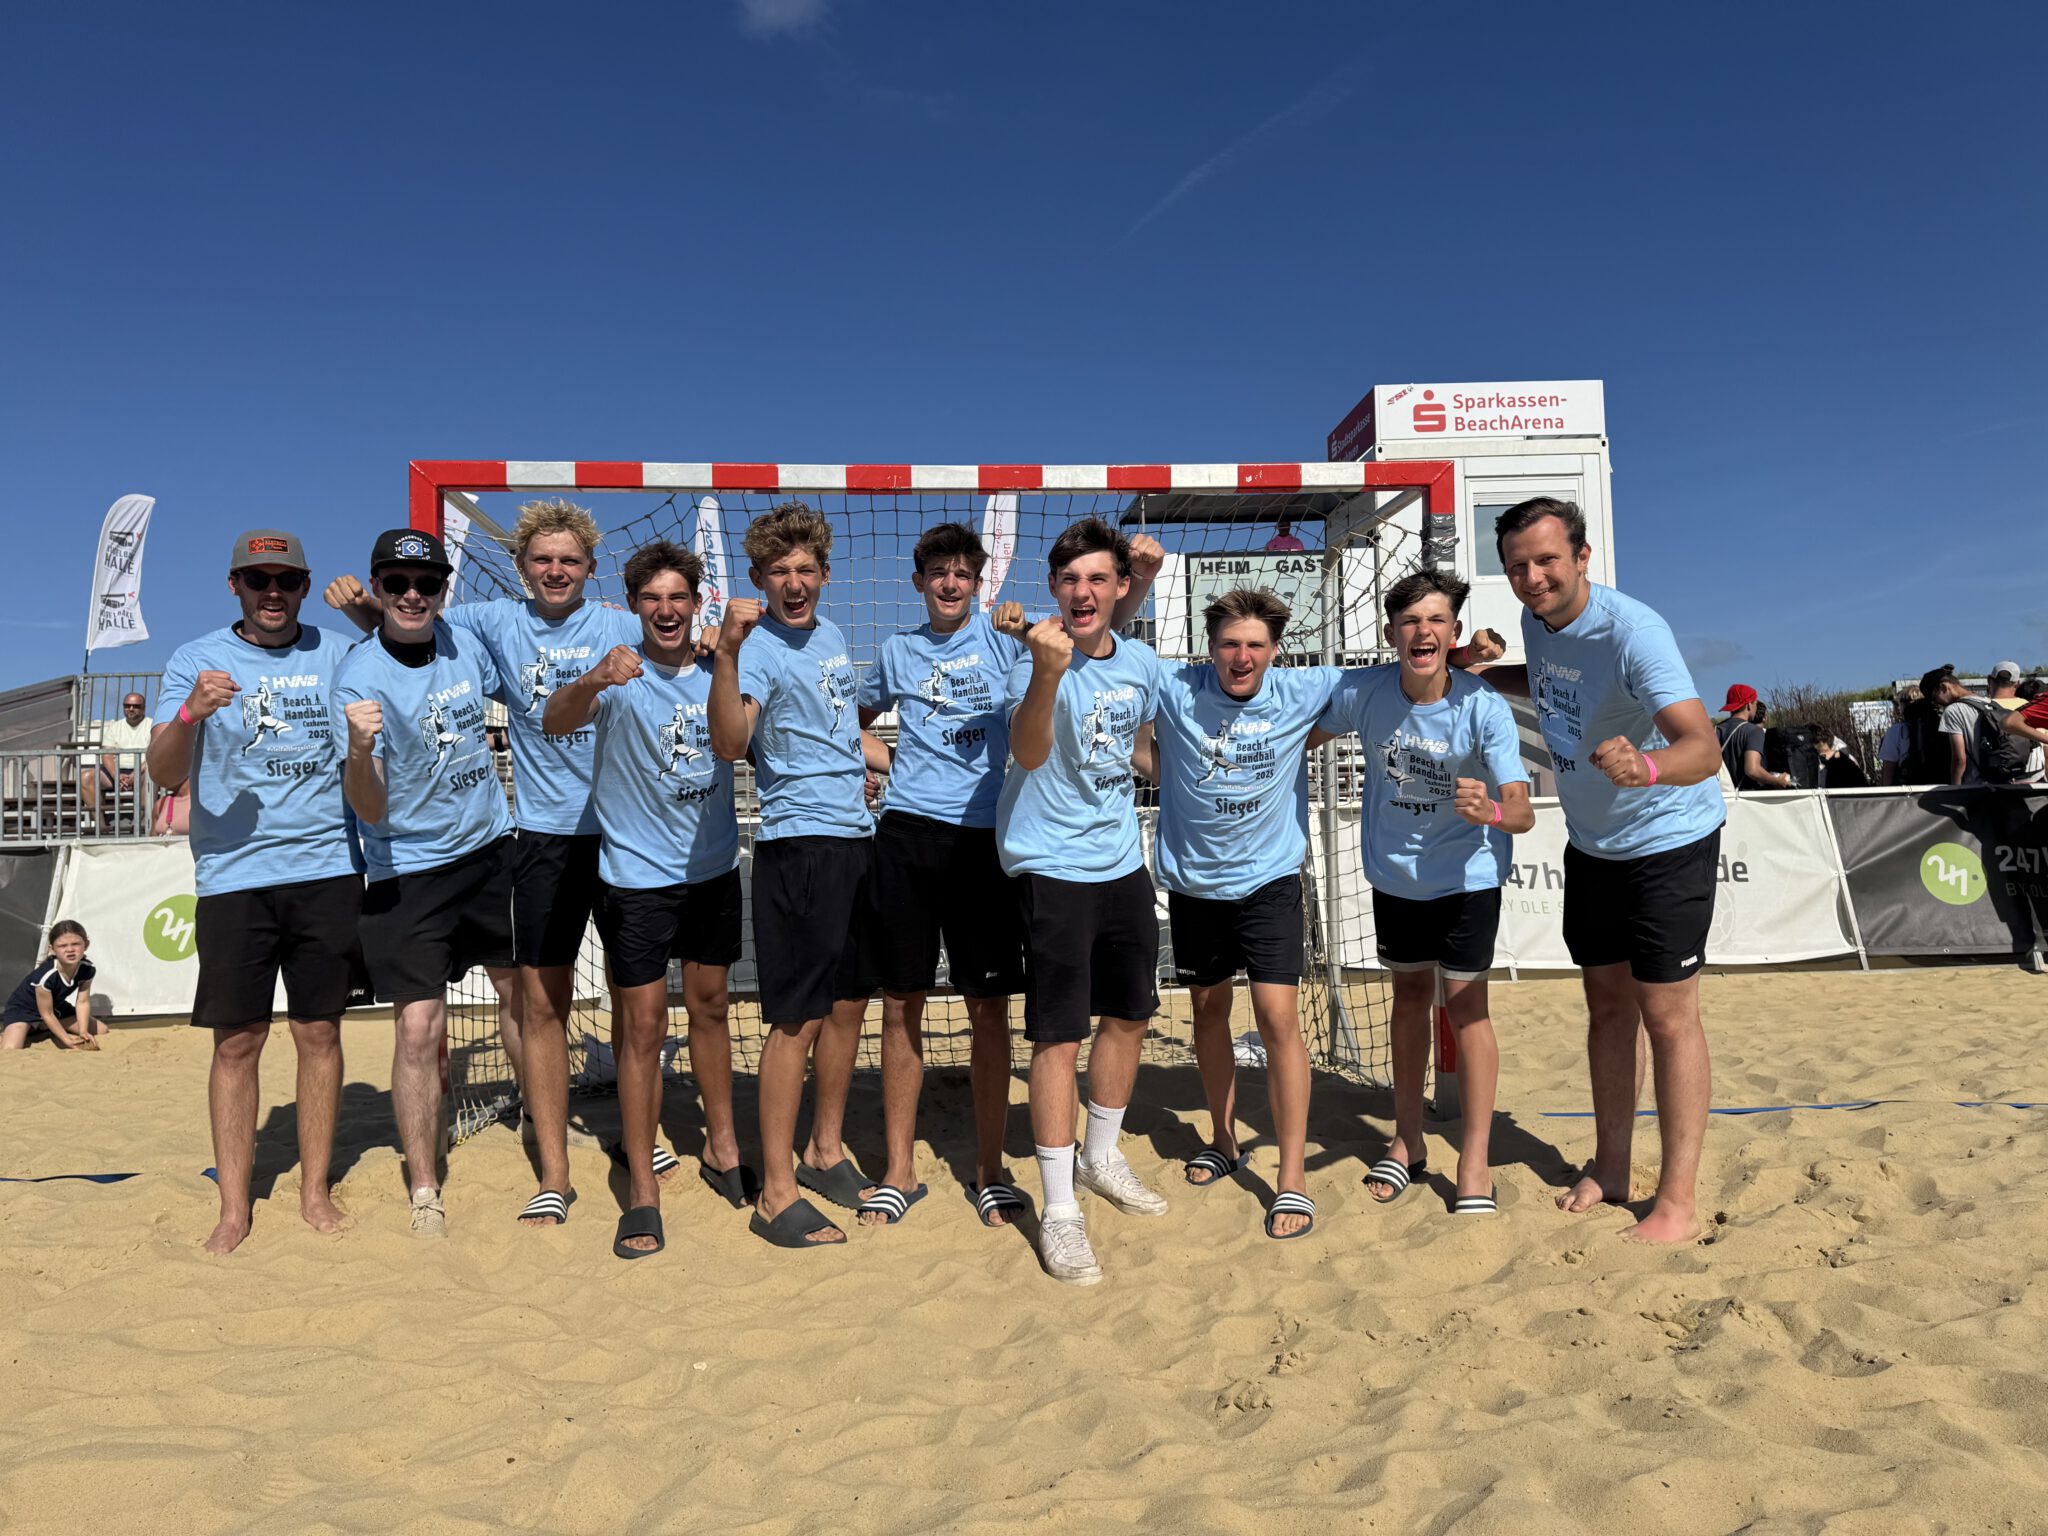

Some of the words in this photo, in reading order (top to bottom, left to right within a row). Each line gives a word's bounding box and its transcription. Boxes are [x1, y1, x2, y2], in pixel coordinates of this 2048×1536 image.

[1453, 392, 1567, 412] Sparkassen-
[1454, 415, 1564, 432] BeachArena
[1200, 560, 1249, 574] HEIM
[98, 616, 136, 631] HALLE
[556, 666, 581, 679] Beach
[950, 673, 974, 688] Beach
[952, 682, 990, 698] Handball
[1552, 684, 1569, 699] Beach
[283, 694, 311, 708] Beach
[967, 695, 991, 704] Cuxhaven
[973, 702, 992, 711] 2025
[284, 706, 328, 720] Handball
[451, 701, 474, 720] Beach
[1110, 707, 1130, 723] Beach
[1553, 698, 1580, 718] Handball
[308, 729, 330, 740] 2025
[942, 727, 986, 748] Sieger
[1567, 725, 1582, 740] 2025
[1236, 739, 1261, 751] Beach
[1235, 748, 1275, 763] Handball
[1409, 754, 1435, 769] Beach
[266, 759, 318, 780] Sieger
[1252, 761, 1275, 770] Cuxhaven
[449, 765, 489, 792] Sieger
[1256, 769, 1274, 780] 2025
[1409, 765, 1451, 782] Handball
[677, 782, 719, 803] Sieger
[1429, 787, 1451, 797] 2025
[1215, 797, 1260, 819] Sieger
